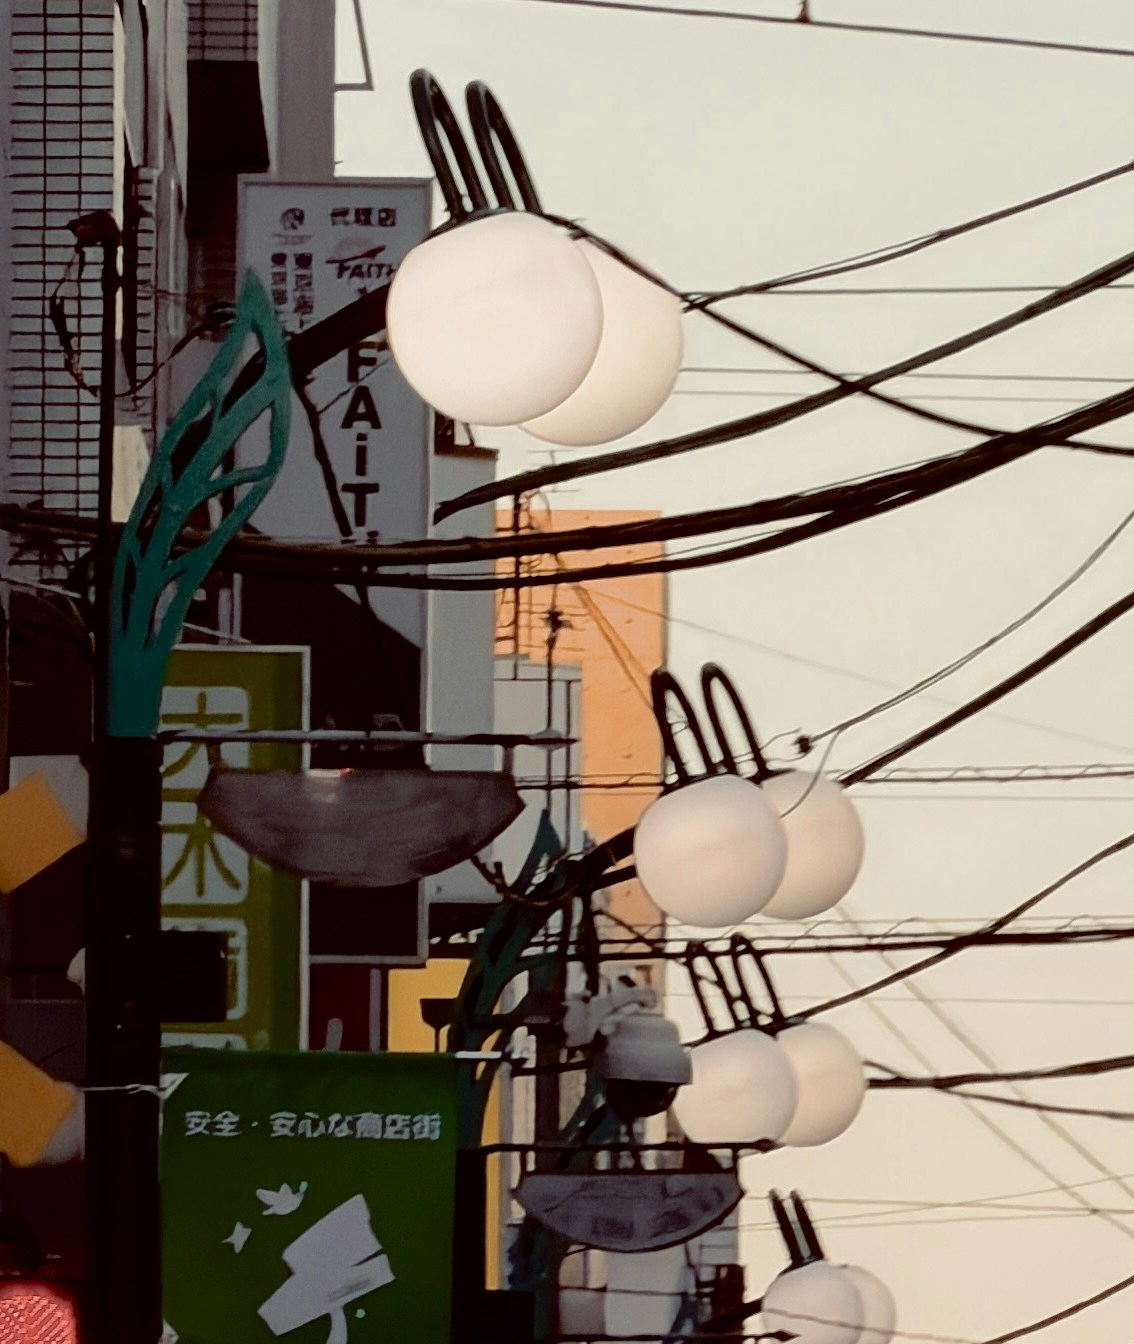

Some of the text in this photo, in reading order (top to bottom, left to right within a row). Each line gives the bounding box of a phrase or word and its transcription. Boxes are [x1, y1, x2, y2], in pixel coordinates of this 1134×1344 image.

[341, 341, 388, 544] FAiT
[184, 1110, 442, 1140] 安全・安心な商店街
